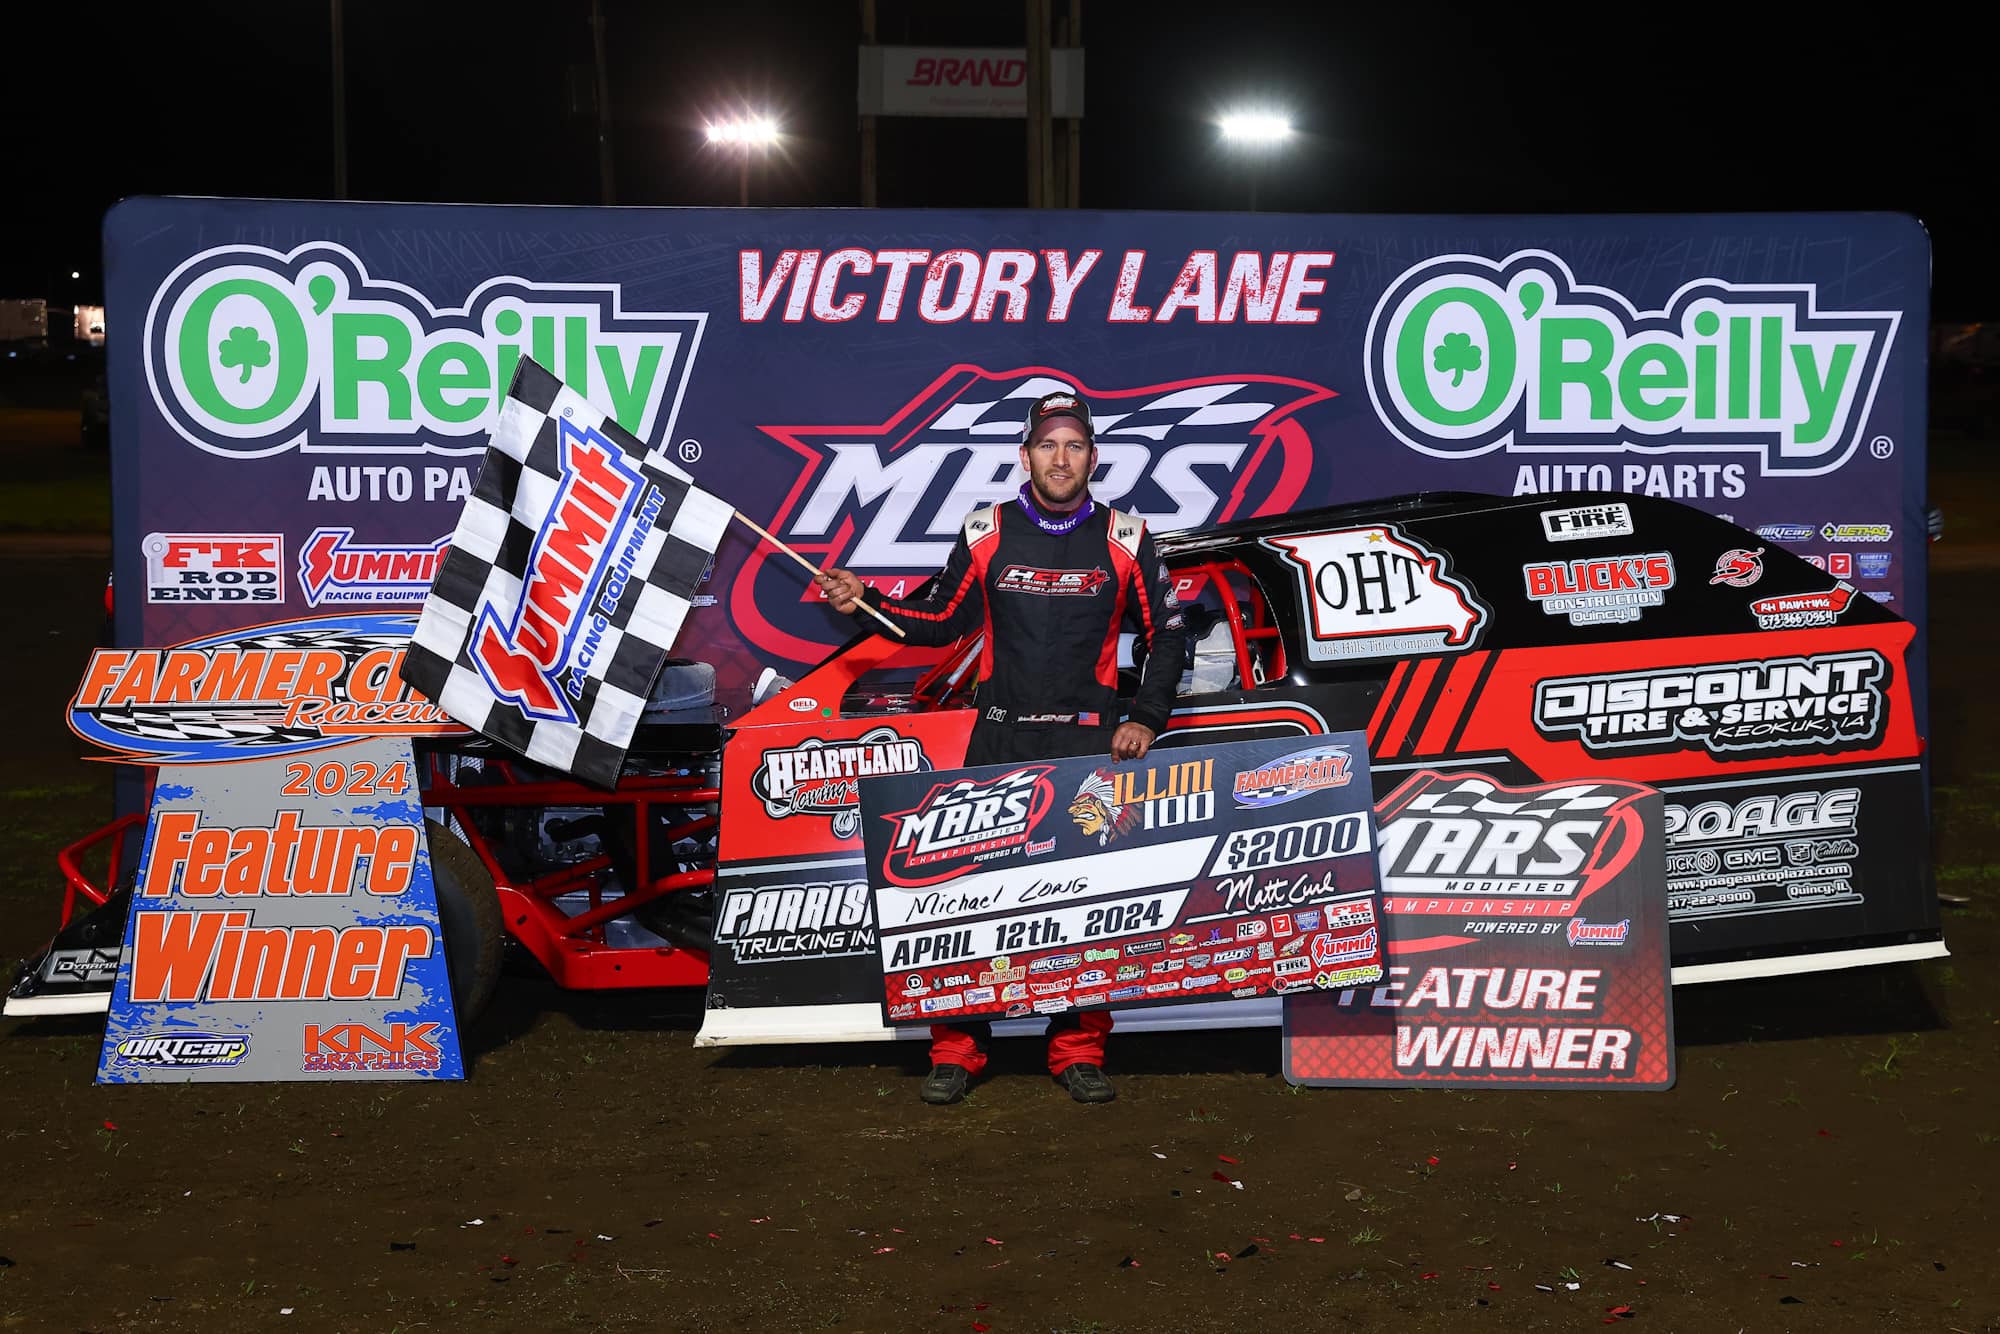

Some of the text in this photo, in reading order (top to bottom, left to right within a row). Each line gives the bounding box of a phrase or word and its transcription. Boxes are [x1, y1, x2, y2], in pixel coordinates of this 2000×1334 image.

[739, 248, 1335, 324] VICTORY LANE
[179, 275, 663, 437] O'Reilly
[1395, 281, 1857, 444] O'Reilly
[308, 467, 398, 502] AUTO
[1512, 463, 1746, 498] AUTO PARTS
[1038, 517, 1078, 531] Hoosier
[1548, 511, 1625, 533] FIRE
[1838, 526, 1889, 536] LETHAL
[163, 542, 276, 568] FK
[180, 571, 277, 584] ROD
[1314, 550, 1425, 615] OHT
[1527, 557, 1671, 597] BLICK'S
[151, 587, 277, 600] ENDS
[325, 591, 430, 600] RACING EQUIPM
[567, 487, 665, 700] RACING EQUIPMENT
[1545, 591, 1661, 611] CONSTRUCTION
[1318, 637, 1440, 655] Oak Hills Title Company
[78, 650, 343, 706] FARMER
[1542, 659, 1874, 719] DISCOUNT
[1586, 692, 1870, 738] TIRE & SERVICE
[1840, 714, 1866, 730] IA
[282, 762, 409, 796] 2024
[767, 742, 919, 799] HEARTLAND
[1112, 758, 1214, 807] ILLINI
[1236, 755, 1348, 791] FARMER CITY
[785, 780, 850, 811] Towing
[1143, 790, 1214, 830] 100
[896, 788, 1034, 854] MARS
[144, 810, 420, 897] Feature
[910, 835, 1026, 866] CHAMPIONSHIP
[973, 848, 1010, 863] POWERED
[1011, 846, 1022, 855] BY
[1228, 817, 1361, 870] $2000
[1726, 850, 1777, 866] GMC
[1446, 880, 1575, 893] MODIFIED
[1667, 864, 1849, 890] www.poageautoplaza.com
[1790, 882, 1834, 897] Quincy,
[1836, 880, 1848, 892] IL
[721, 883, 873, 937] PARRIS
[905, 883, 1003, 922] Michael
[1331, 902, 1369, 917] FK
[1338, 912, 1371, 921] ROD
[1383, 901, 1572, 915] AMPIONSHIP
[889, 900, 1163, 968] APRIL 12th, 2024
[1329, 918, 1372, 928] ENDS
[1463, 920, 1625, 941] POWERED BY SUMMIT
[130, 910, 434, 1003] Winner
[739, 929, 875, 955] TRUCKING IN
[1315, 934, 1372, 960] SUMMIT
[1031, 980, 1070, 992] WHELEN
[1116, 970, 1146, 982] DRAFT
[1331, 966, 1378, 982] LETHAL
[1337, 967, 1601, 1009] EATURE
[305, 1023, 440, 1053] KNK
[1397, 1025, 1633, 1069] WINNER
[305, 1052, 440, 1064] GRAPHICS
